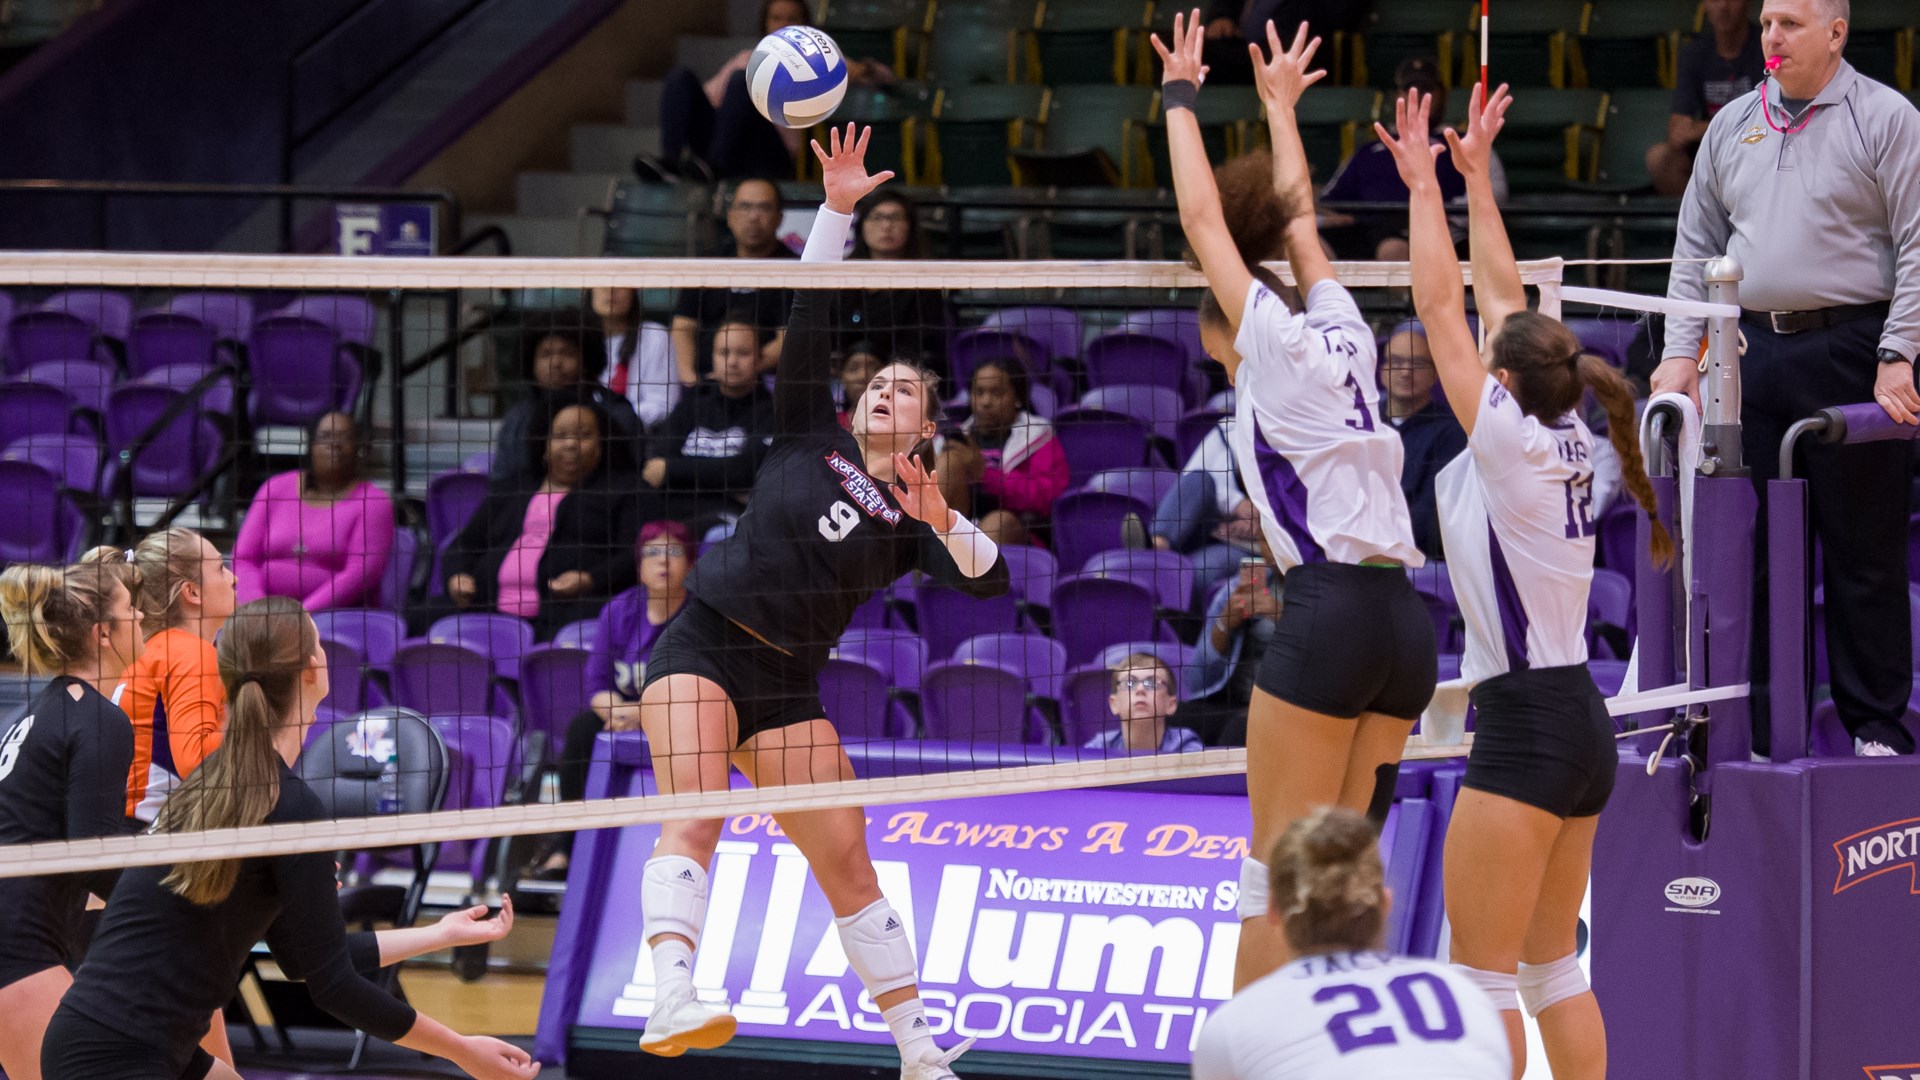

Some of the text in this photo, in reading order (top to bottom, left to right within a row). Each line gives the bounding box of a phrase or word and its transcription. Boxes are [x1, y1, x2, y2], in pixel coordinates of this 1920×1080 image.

[846, 480, 878, 513] STATE
[1563, 471, 1597, 540] 12
[818, 500, 861, 543] 9
[0, 714, 36, 782] 8
[1080, 821, 1129, 855] A
[985, 867, 1240, 912] NORTHWESTERN S
[1667, 884, 1717, 897] SNA
[1312, 972, 1466, 1054] 20
